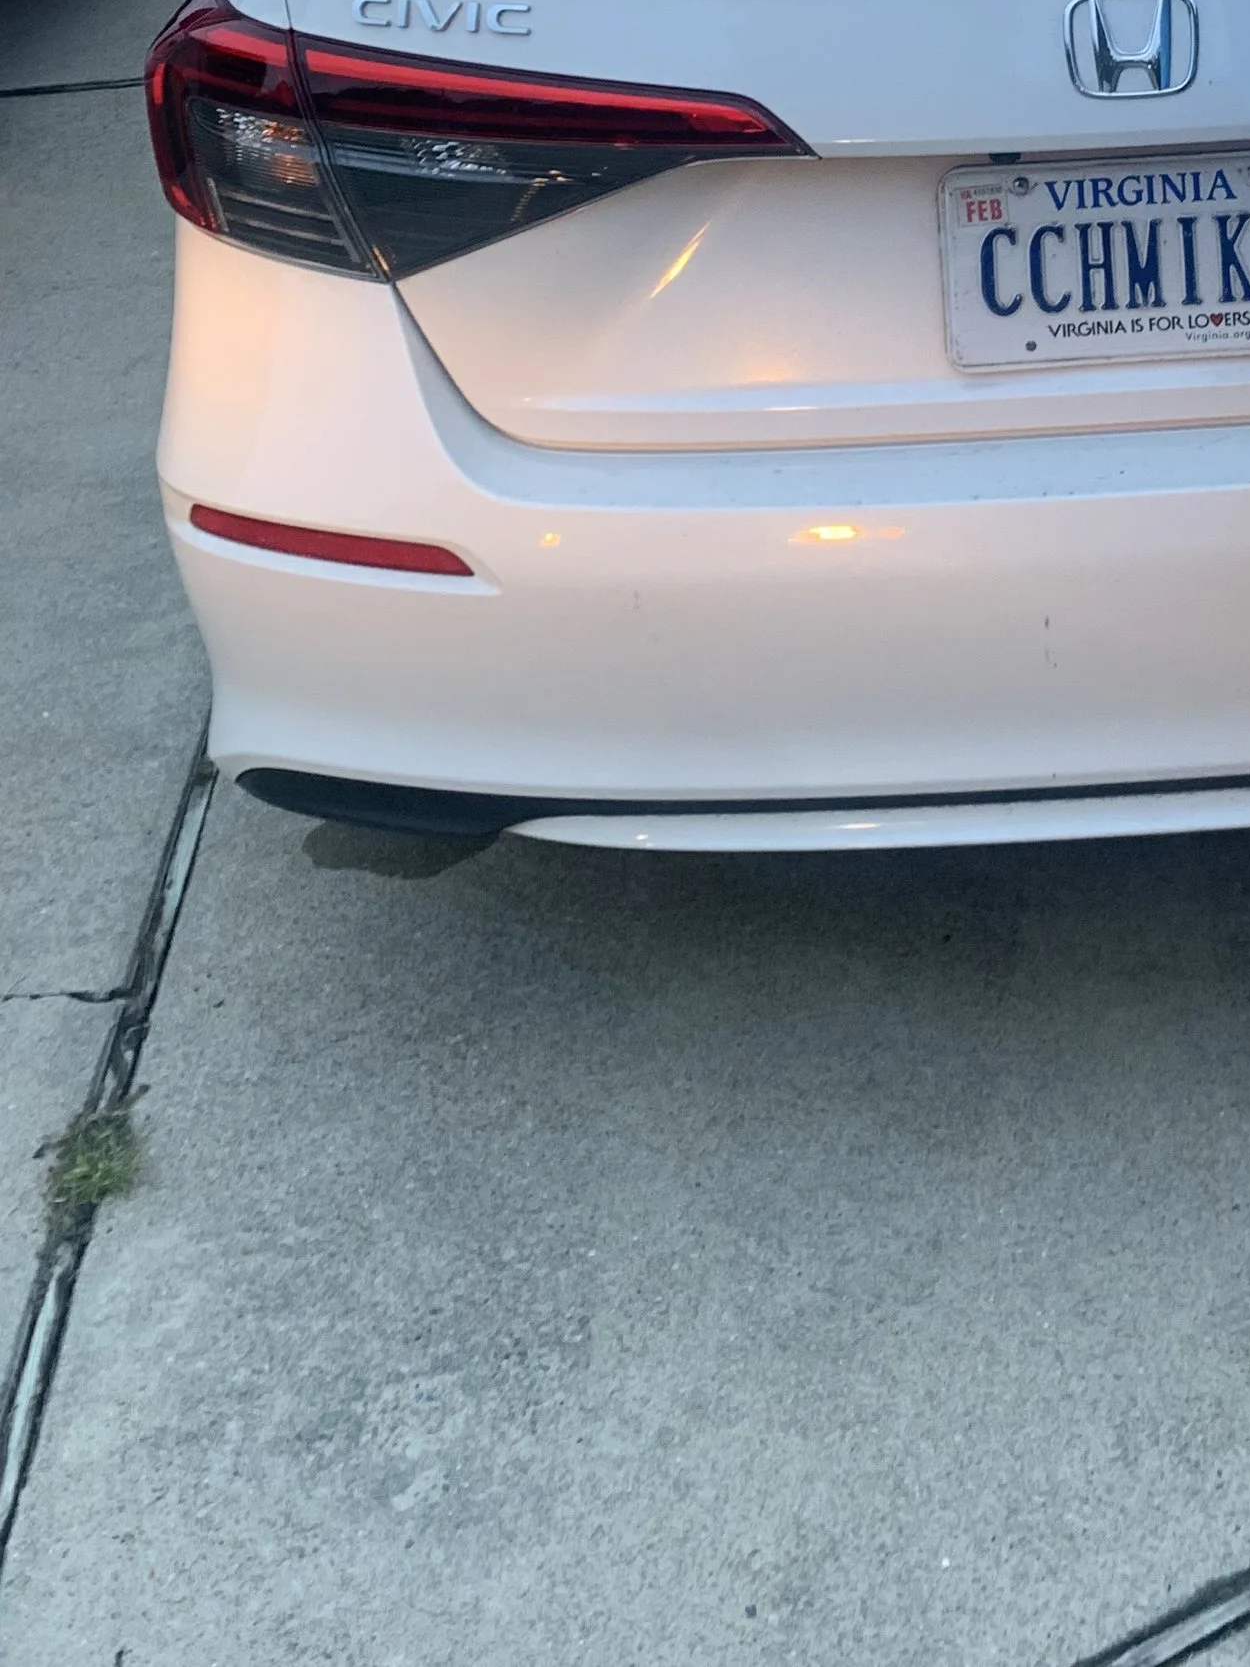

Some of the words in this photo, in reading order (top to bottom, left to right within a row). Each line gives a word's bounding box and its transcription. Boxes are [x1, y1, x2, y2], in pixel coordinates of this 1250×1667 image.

[1044, 168, 1238, 211] VIRGINIA
[966, 199, 1002, 223] FEB
[1048, 319, 1127, 338] VIRGINIA
[1131, 318, 1144, 333] IS
[1149, 316, 1184, 332] FOR
